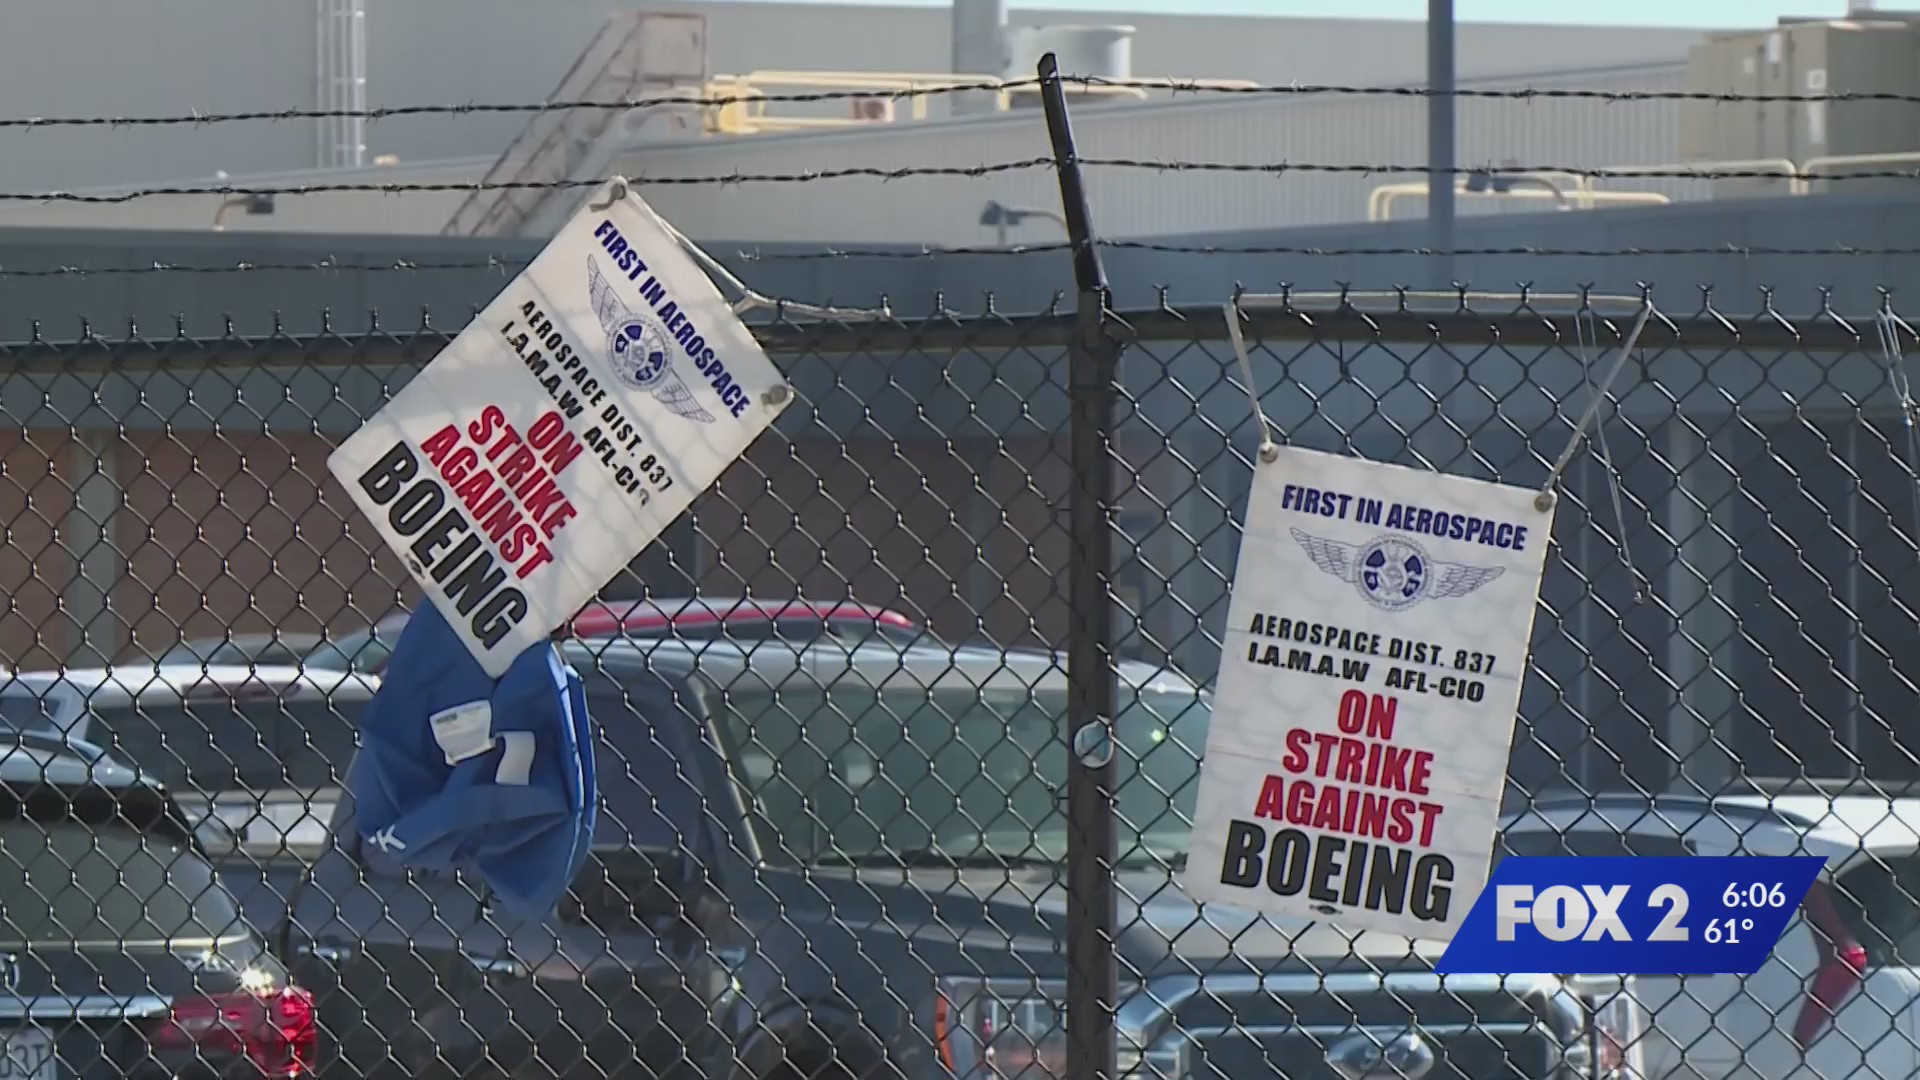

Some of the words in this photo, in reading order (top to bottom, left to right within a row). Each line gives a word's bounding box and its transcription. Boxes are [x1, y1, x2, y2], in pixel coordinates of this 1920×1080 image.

[594, 219, 648, 281] FIRST
[639, 276, 666, 307] IN
[657, 301, 751, 419] AEROSPACE
[500, 321, 584, 420] I.A.M.A.W
[521, 300, 608, 407] AEROSPACE
[601, 403, 643, 457] DIST.
[639, 454, 674, 493] 837
[468, 404, 578, 540] STRIKE
[527, 410, 584, 476] ON
[420, 423, 554, 580] AGAINST
[1281, 484, 1353, 519] FIRST
[1355, 496, 1383, 526] IN
[1385, 503, 1528, 551] AEROSPACE
[357, 439, 528, 651] BOEING
[1247, 642, 1370, 683] I.A.M.A.W
[1384, 666, 1485, 703] AFL-CIO
[1250, 613, 1381, 656] AEROSPACE
[1388, 637, 1445, 668] DIST.
[1453, 649, 1496, 676] 837
[1337, 688, 1398, 741] ON
[1282, 727, 1434, 796] STRIKE
[1254, 774, 1444, 848] AGAINST
[1220, 818, 1455, 923] BOEING
